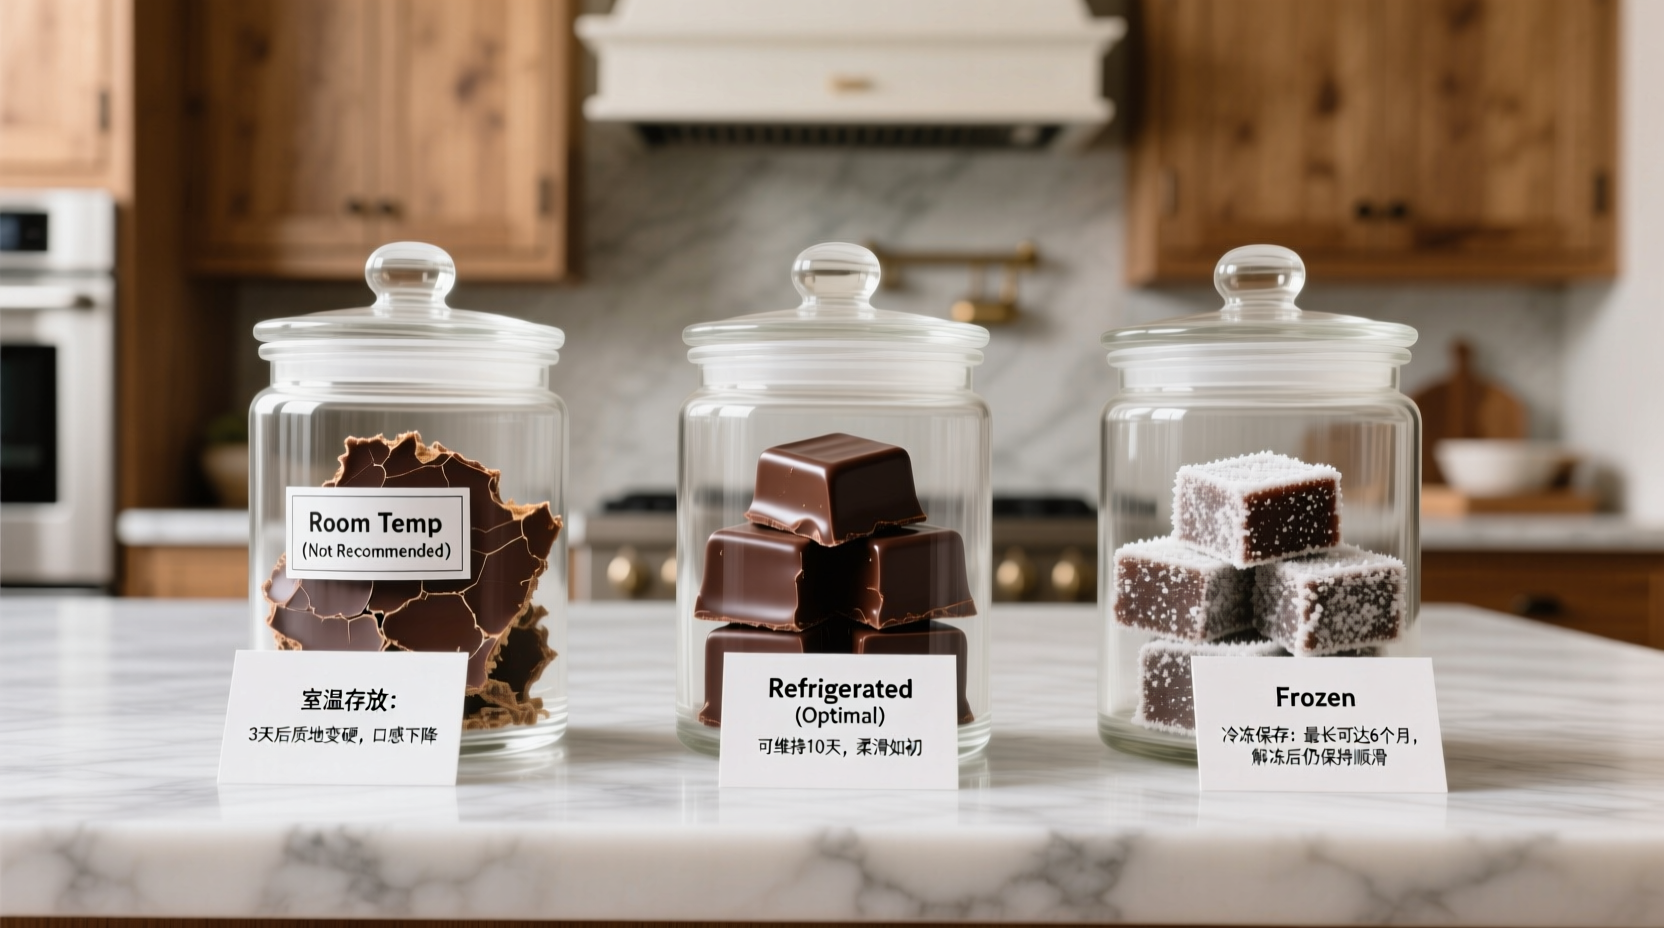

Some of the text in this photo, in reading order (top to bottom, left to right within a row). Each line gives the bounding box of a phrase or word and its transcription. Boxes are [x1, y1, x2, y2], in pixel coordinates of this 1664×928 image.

[309, 511, 443, 538] Room Temp
[302, 541, 452, 561] (Not Recommended)
[768, 677, 913, 705] Refrigerated
[1276, 686, 1356, 708] Frozen
[795, 705, 885, 729] (Optimal)
